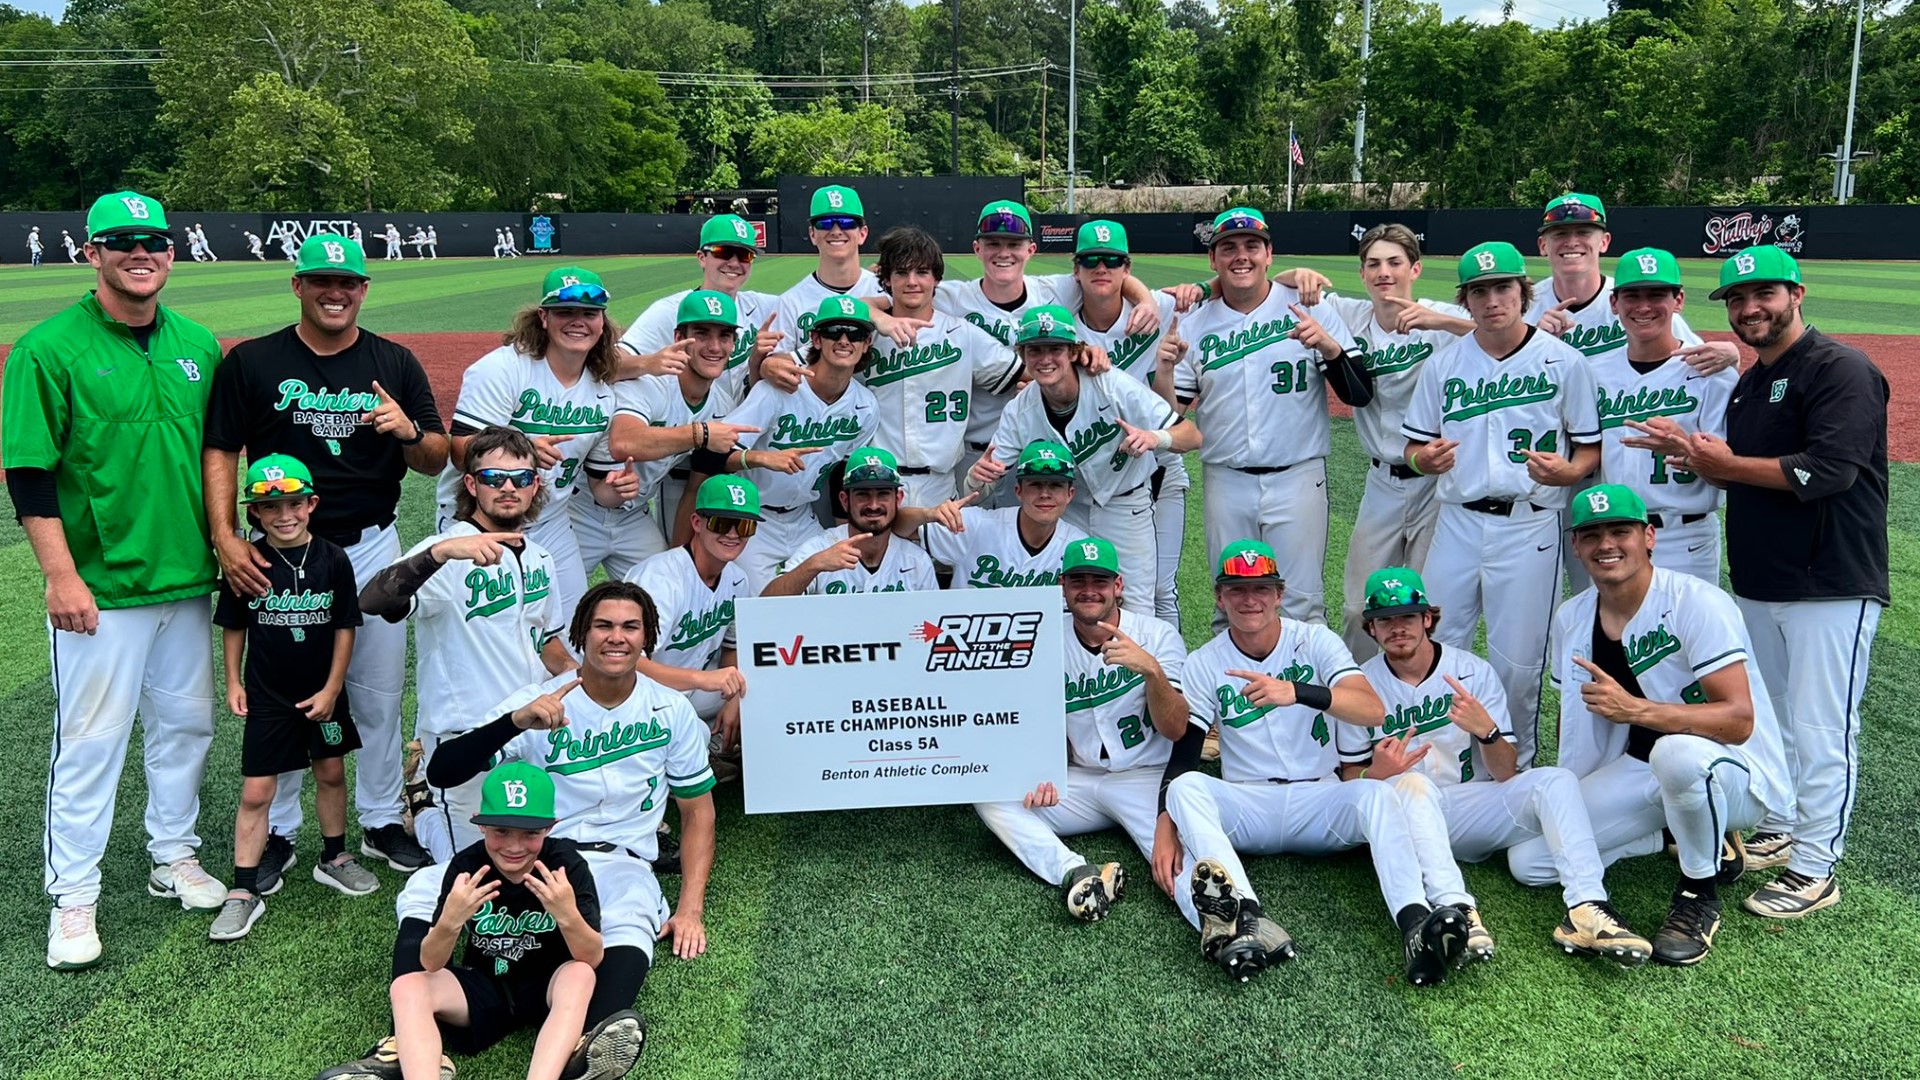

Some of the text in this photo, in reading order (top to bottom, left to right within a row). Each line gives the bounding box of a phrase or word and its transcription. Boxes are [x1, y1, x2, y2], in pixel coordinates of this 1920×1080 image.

[1199, 314, 1300, 365] Pointers
[1271, 359, 1308, 394] 31
[1441, 371, 1558, 413] Pointers
[511, 388, 610, 426] Pointers
[924, 389, 970, 423] 23
[311, 424, 356, 438] CAMP
[1507, 428, 1558, 464] 34
[934, 612, 1043, 651] RIDE
[972, 642, 1012, 651] TO THE
[753, 634, 902, 667] EVERETT
[926, 648, 1033, 672] FINALS
[851, 696, 948, 714] BASEBALL
[785, 711, 1020, 735] STATE CHAMPIONSHIP GAME
[1311, 712, 1330, 748] 4
[545, 717, 668, 763] Pointers
[868, 737, 939, 752] Class 5A
[821, 763, 990, 781] Benton Athletic Complex
[502, 780, 527, 808] VB
